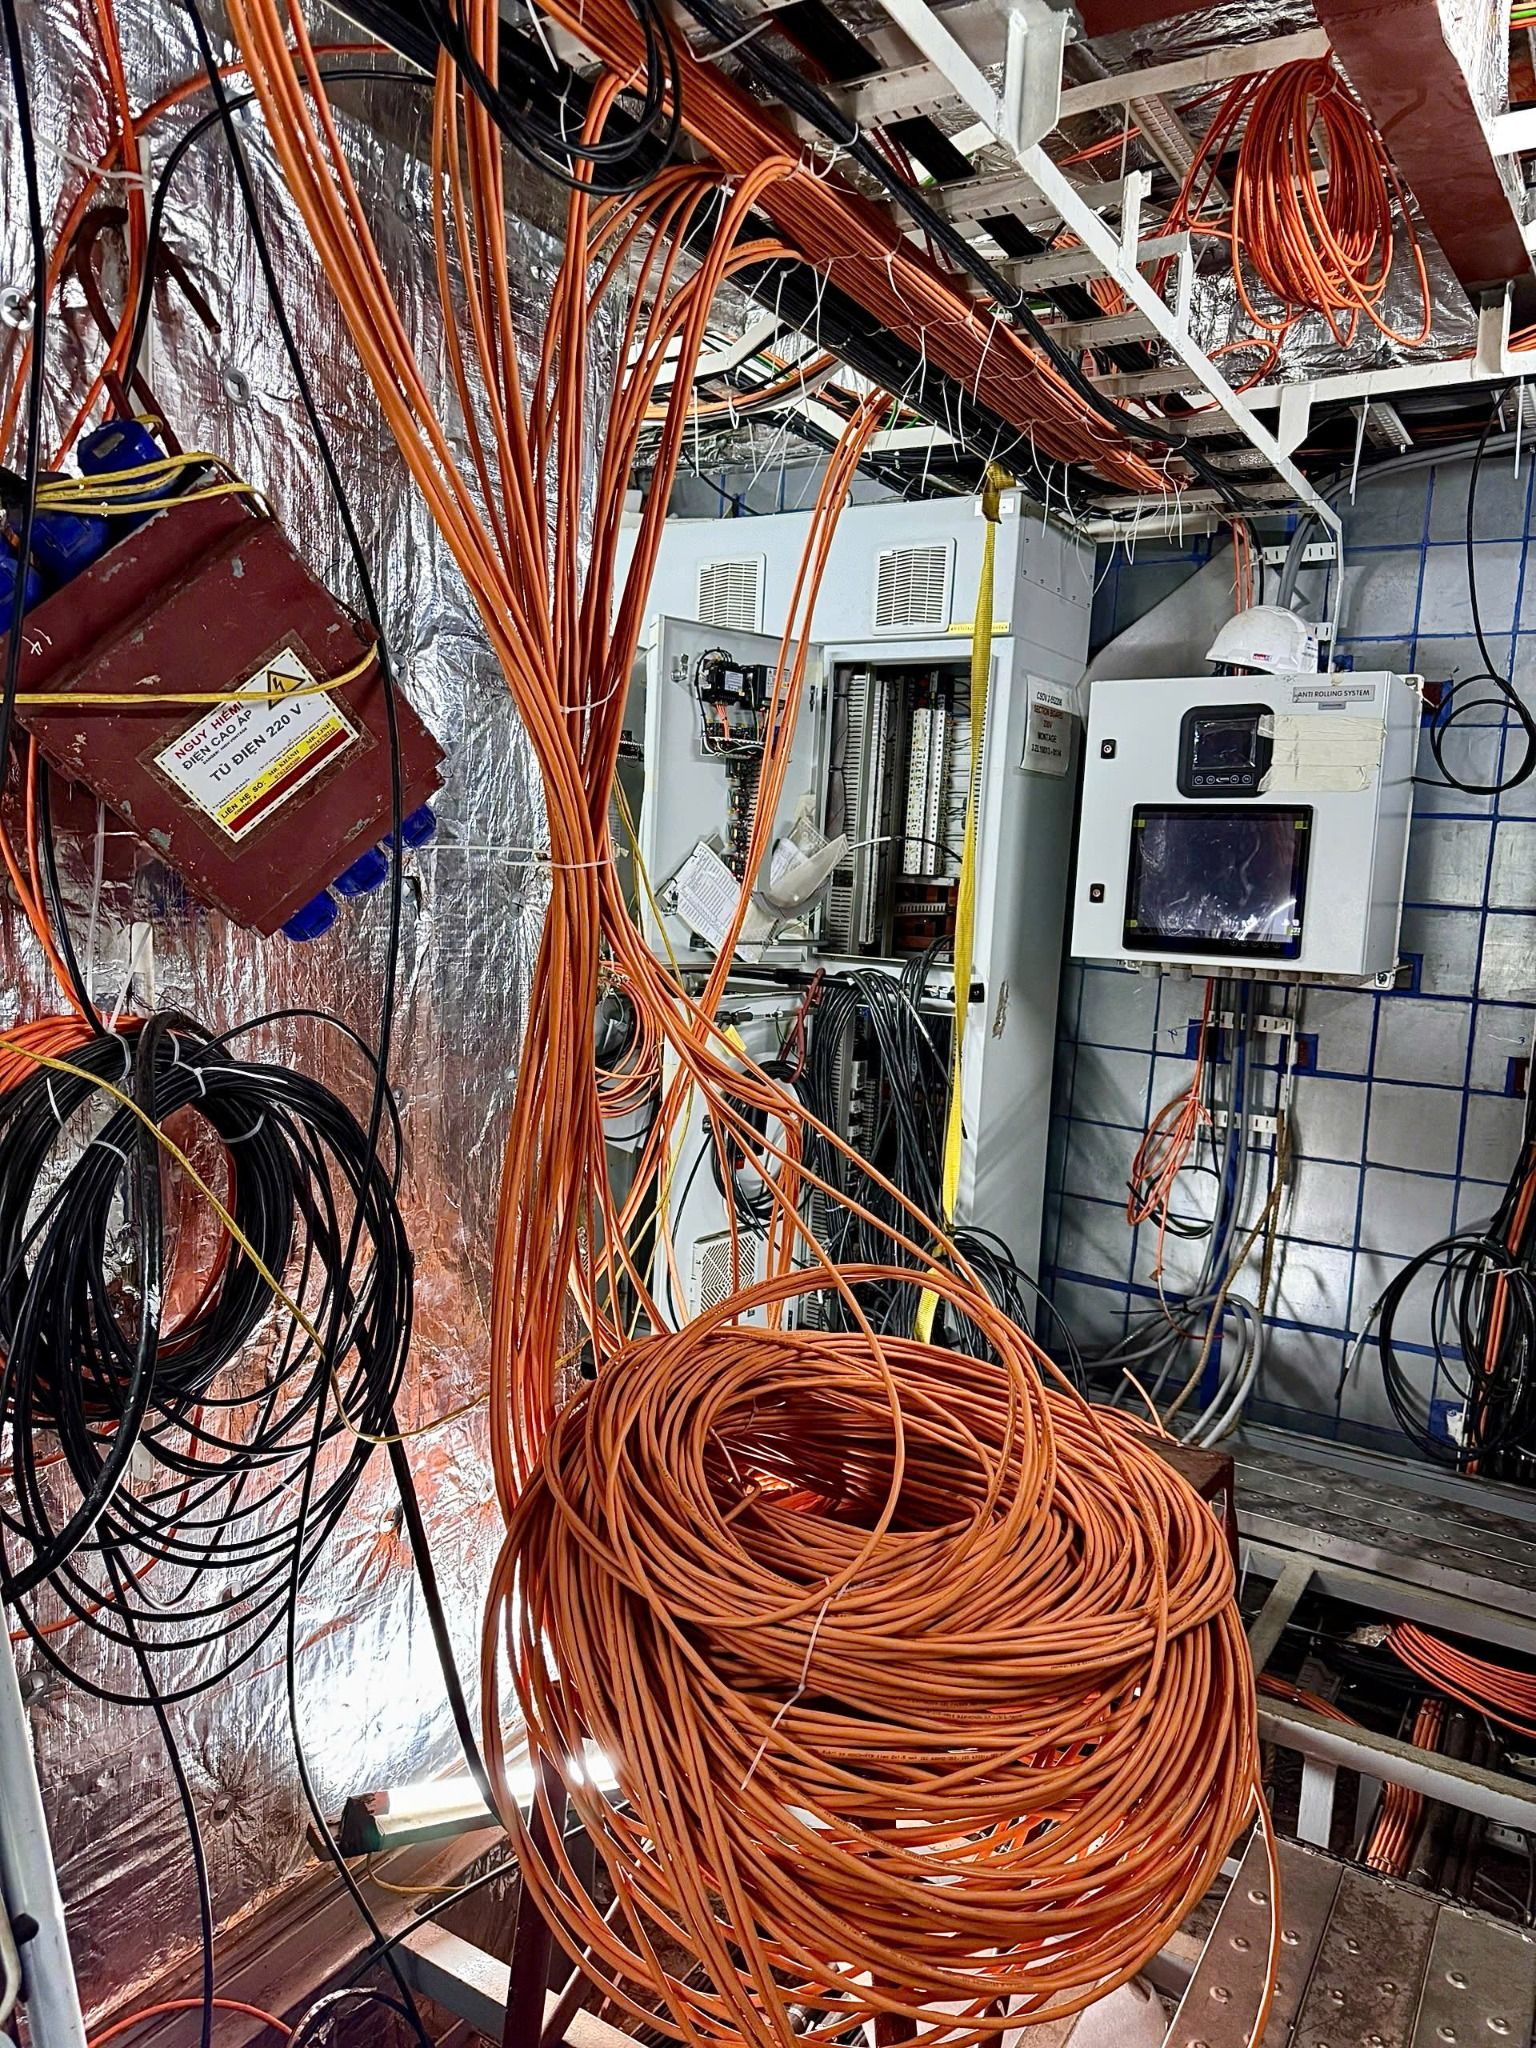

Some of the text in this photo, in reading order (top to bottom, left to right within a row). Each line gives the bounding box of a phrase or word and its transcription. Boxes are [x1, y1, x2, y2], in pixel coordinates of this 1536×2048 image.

[1343, 689, 1370, 697] SYSTEM
[181, 709, 253, 772] ĐIỆN CAO ÁP
[316, 722, 331, 736] LINH
[174, 730, 207, 759] NGUY
[209, 762, 232, 782] TỦ
[231, 734, 267, 766] ĐIỆN
[265, 714, 291, 737] 220
[290, 703, 303, 716] V
[220, 802, 238, 819] LIÊN
